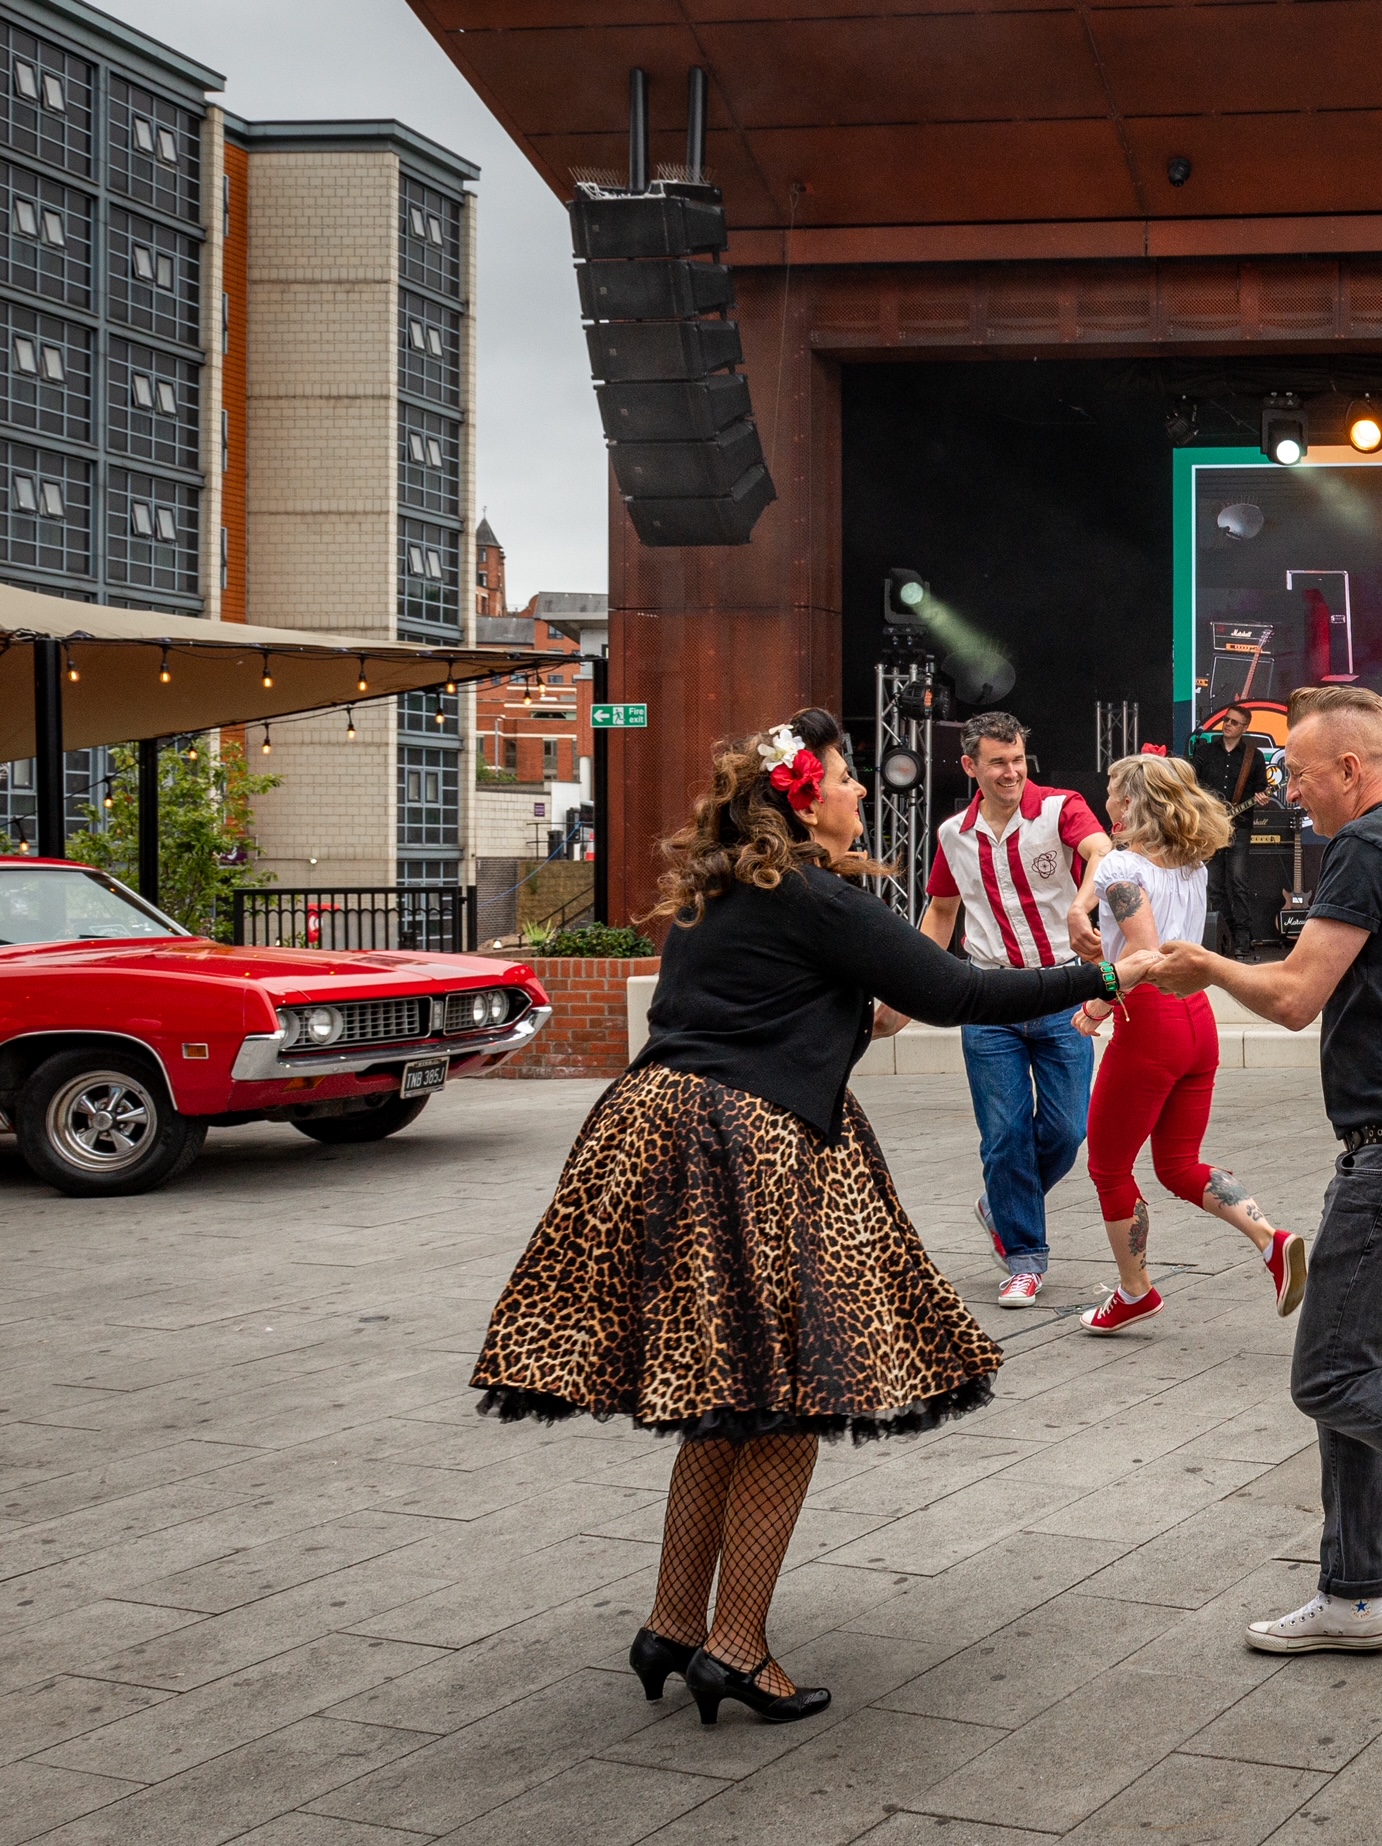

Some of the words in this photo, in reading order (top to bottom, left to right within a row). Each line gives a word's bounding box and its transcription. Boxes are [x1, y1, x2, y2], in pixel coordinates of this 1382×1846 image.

[628, 707, 644, 715] Fire
[407, 1072, 423, 1089] TNB
[423, 1067, 445, 1085] 385J
